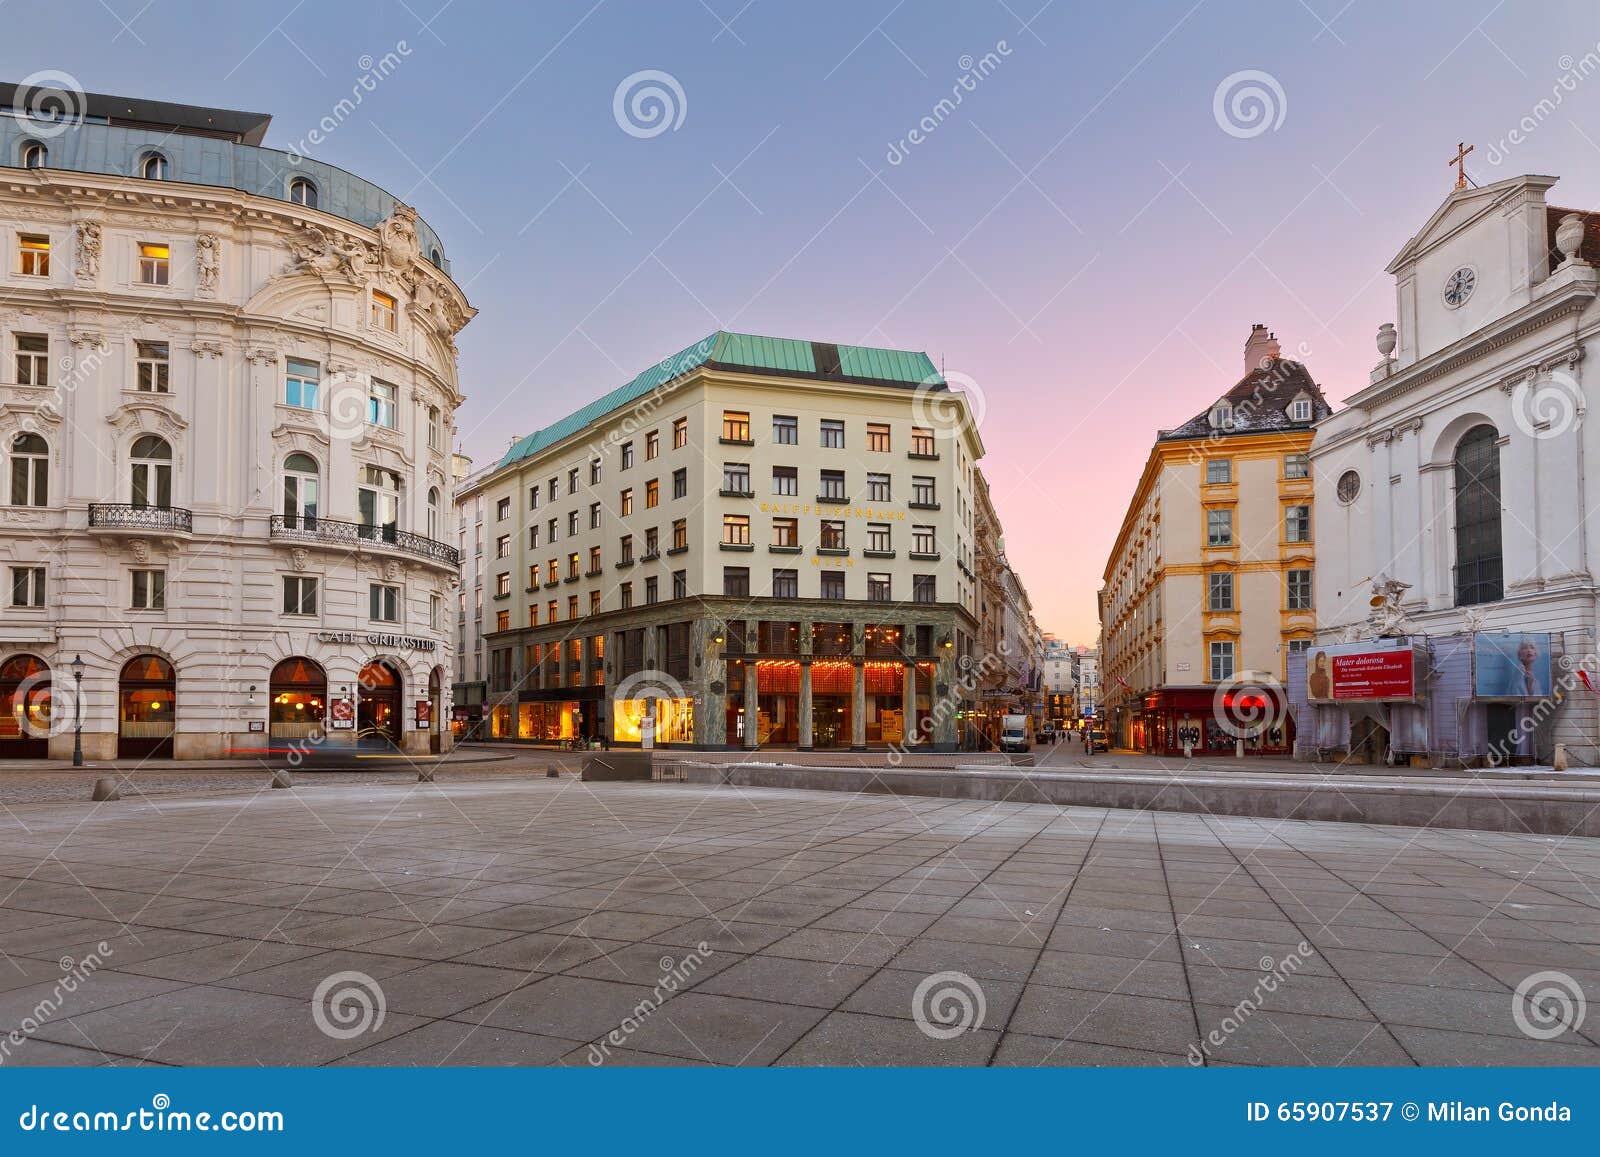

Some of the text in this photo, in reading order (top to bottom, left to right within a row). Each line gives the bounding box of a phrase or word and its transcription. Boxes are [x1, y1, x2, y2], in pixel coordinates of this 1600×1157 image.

[760, 503, 905, 521] RAIFFEISENBANK
[810, 557, 856, 567] WIEN
[1335, 656, 1384, 667] Mater dolorosa
